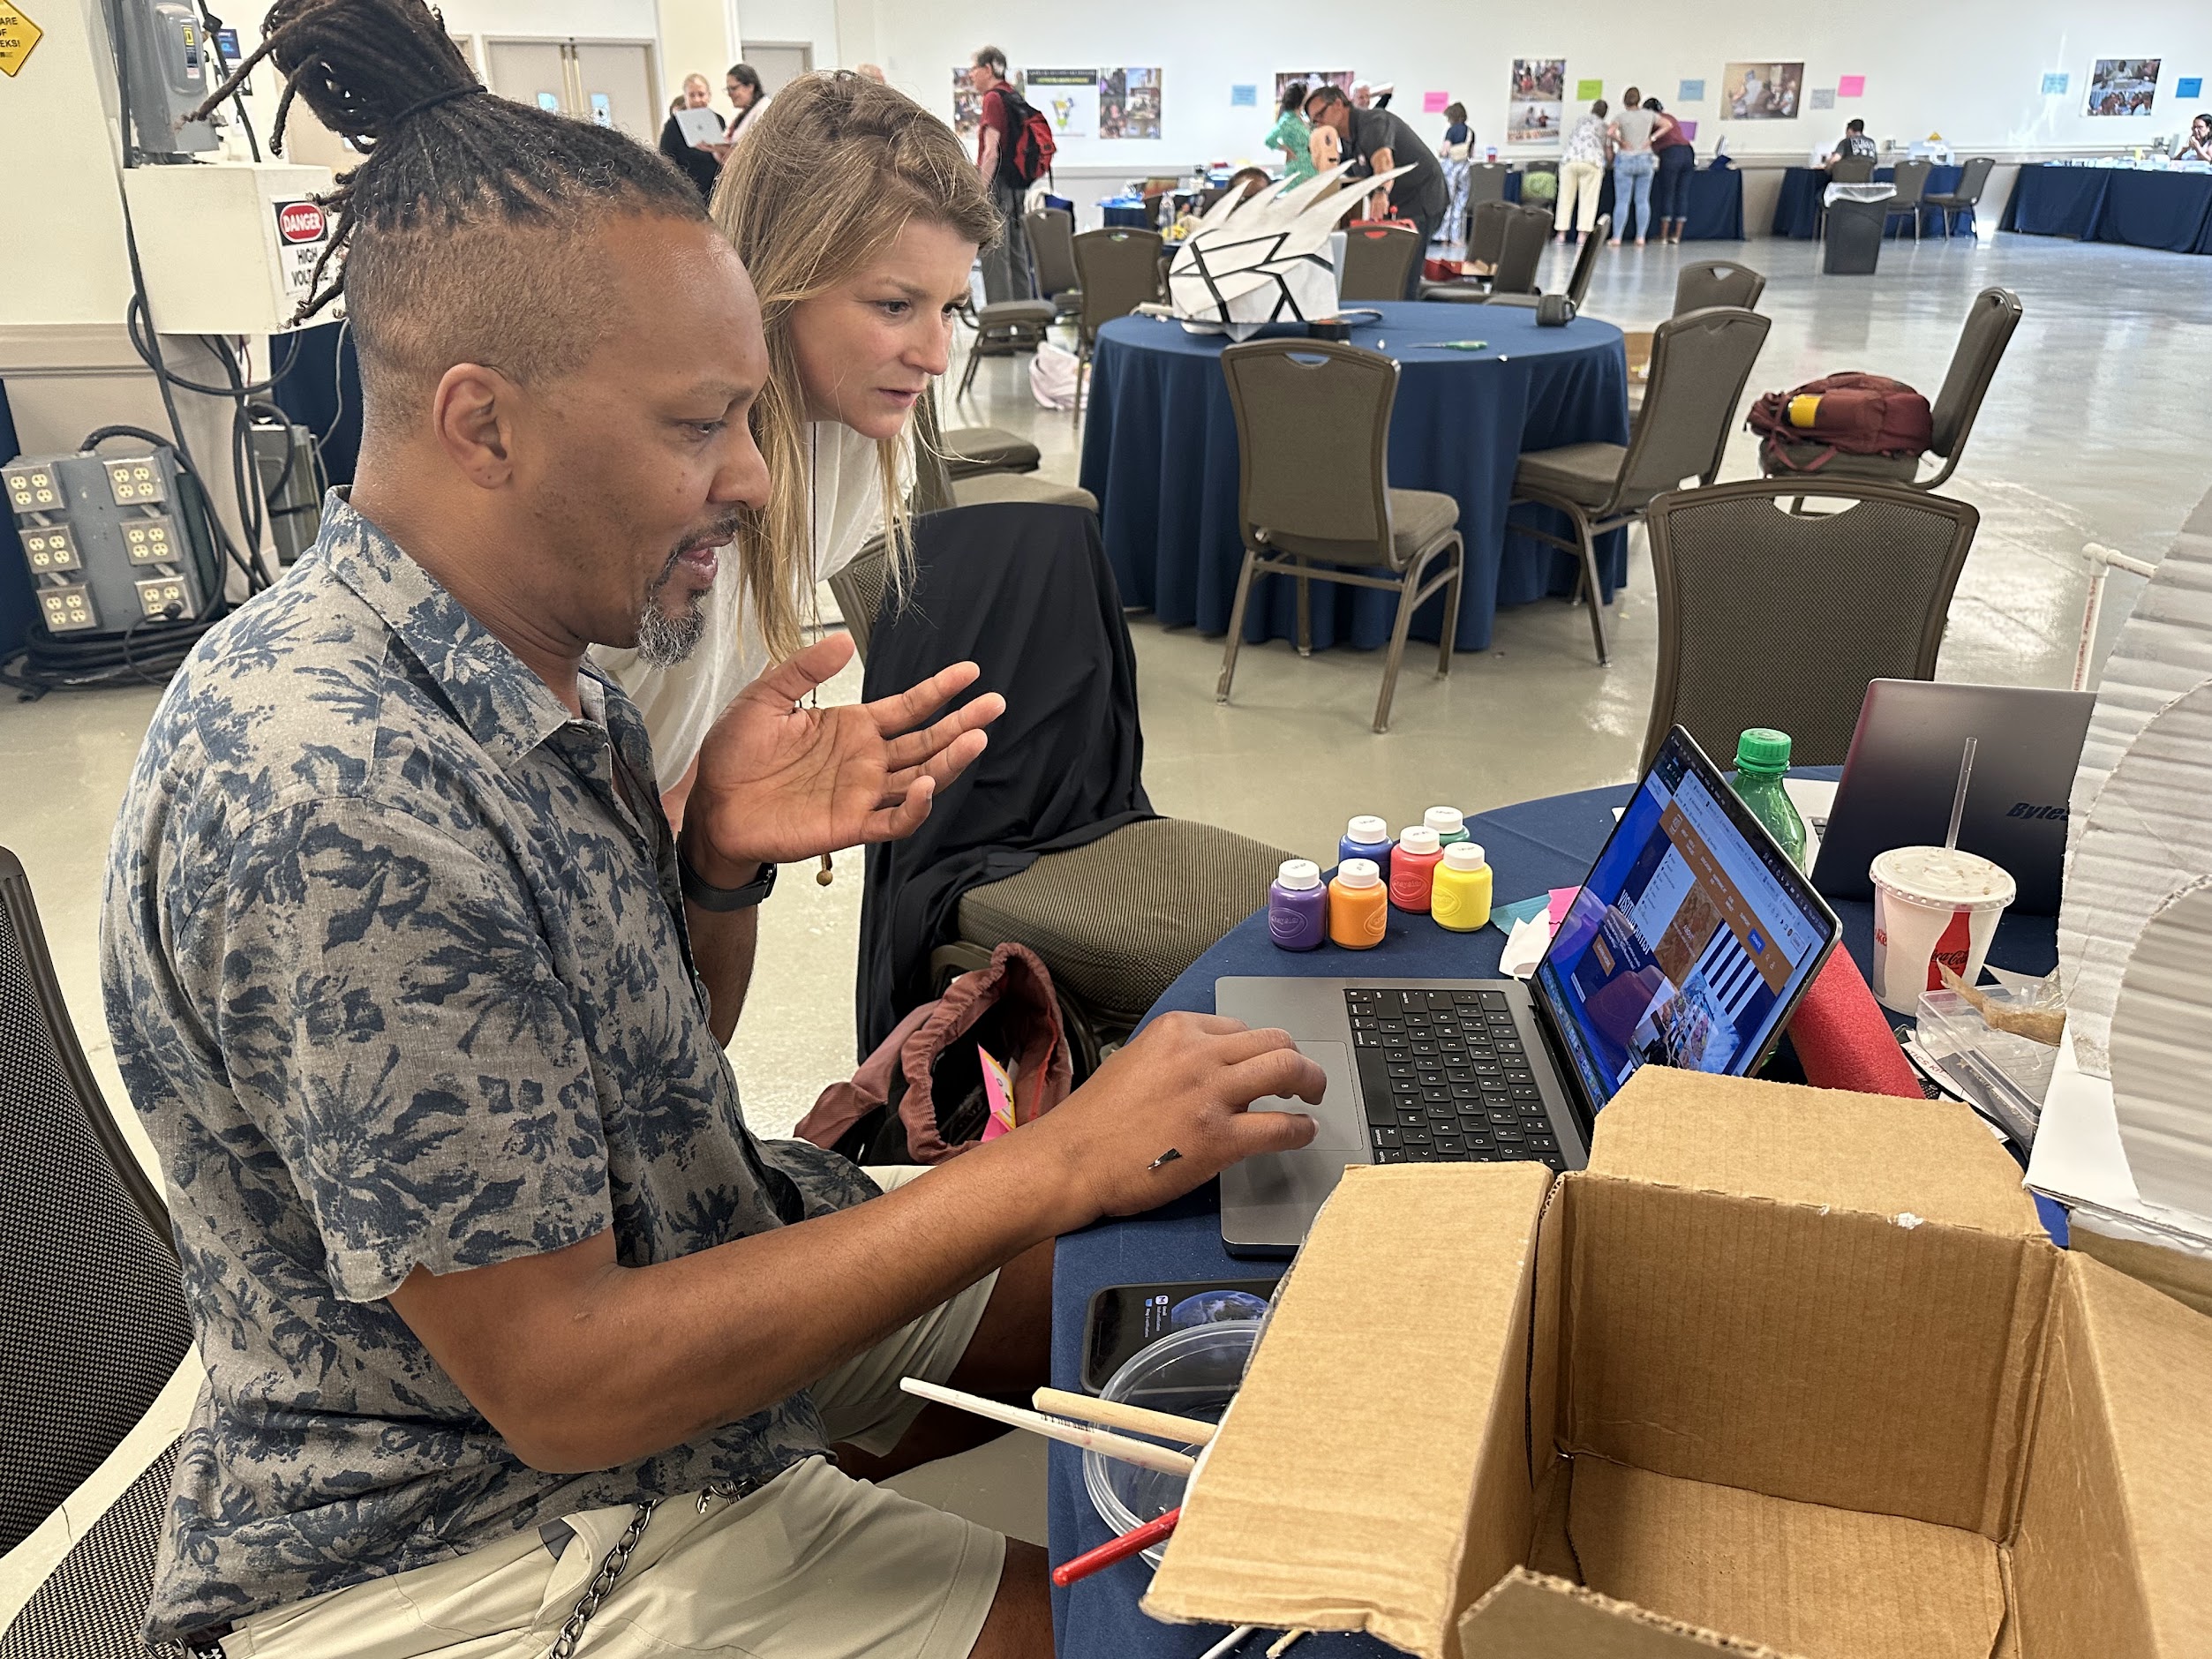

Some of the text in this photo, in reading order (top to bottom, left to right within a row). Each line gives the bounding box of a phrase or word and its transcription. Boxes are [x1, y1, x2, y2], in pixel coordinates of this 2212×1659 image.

[282, 213, 321, 232] DANGER
[297, 247, 318, 265] HIGH
[291, 267, 330, 287] VOLT
